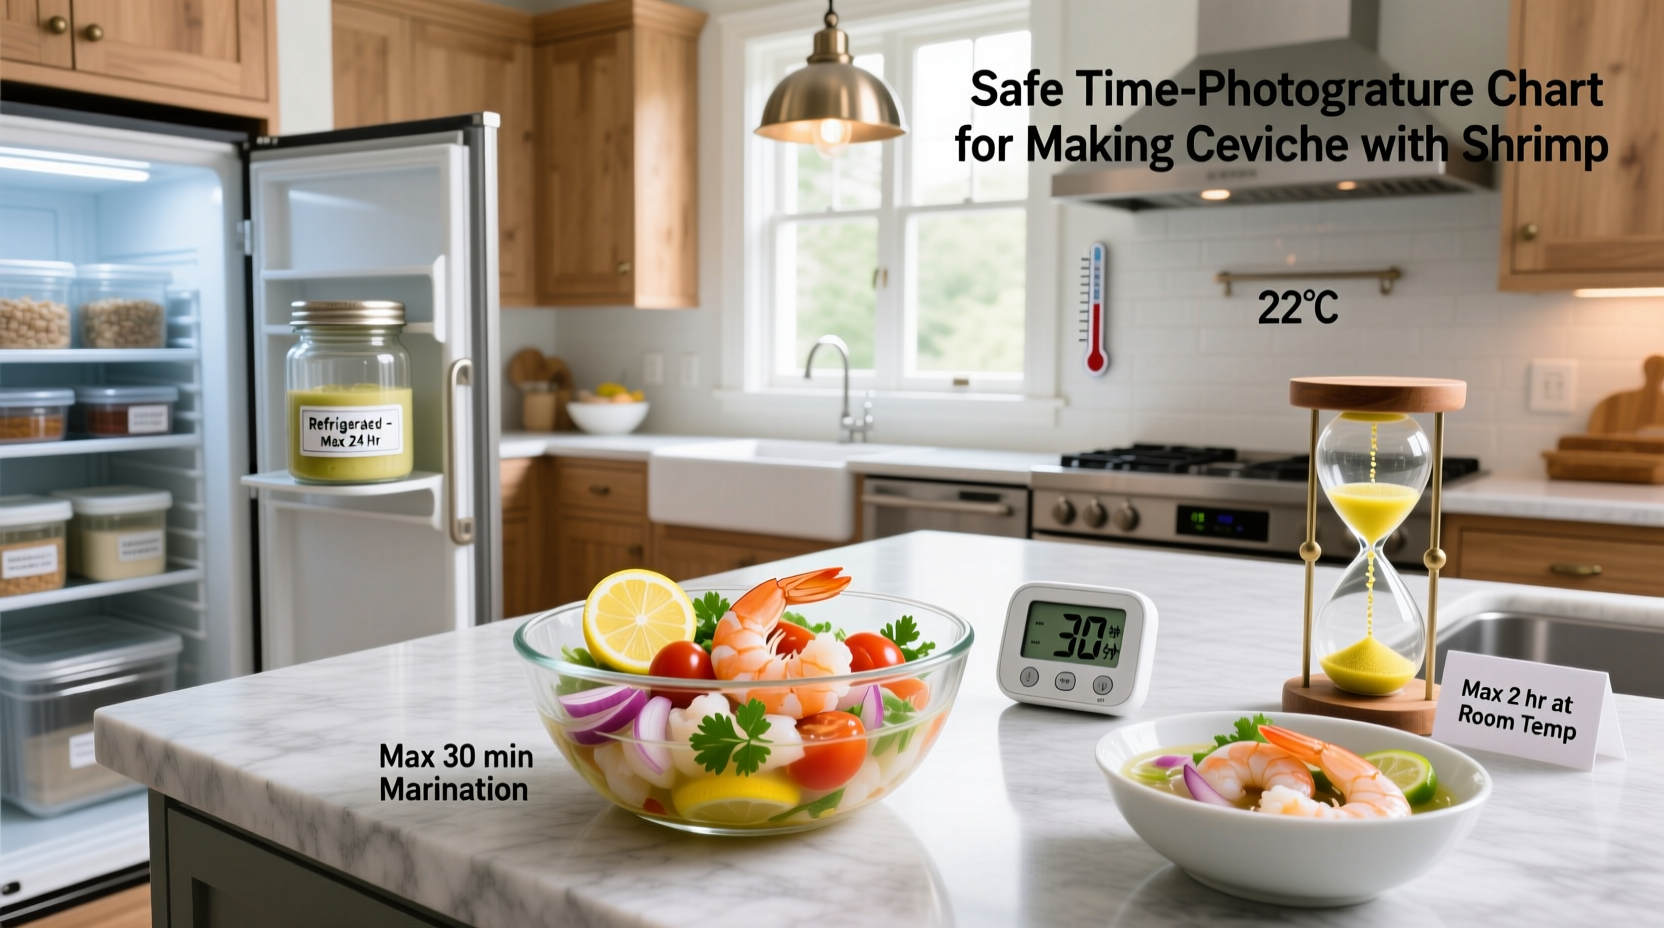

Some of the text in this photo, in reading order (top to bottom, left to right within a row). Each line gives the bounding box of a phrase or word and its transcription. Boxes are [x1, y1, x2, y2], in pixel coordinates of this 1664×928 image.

[348, 434, 364, 447] 24
[367, 434, 380, 446] Hr
[1053, 613, 1107, 660] 30
[1461, 678, 1574, 715] Max 2 hr at
[1458, 703, 1577, 745] Room Temp
